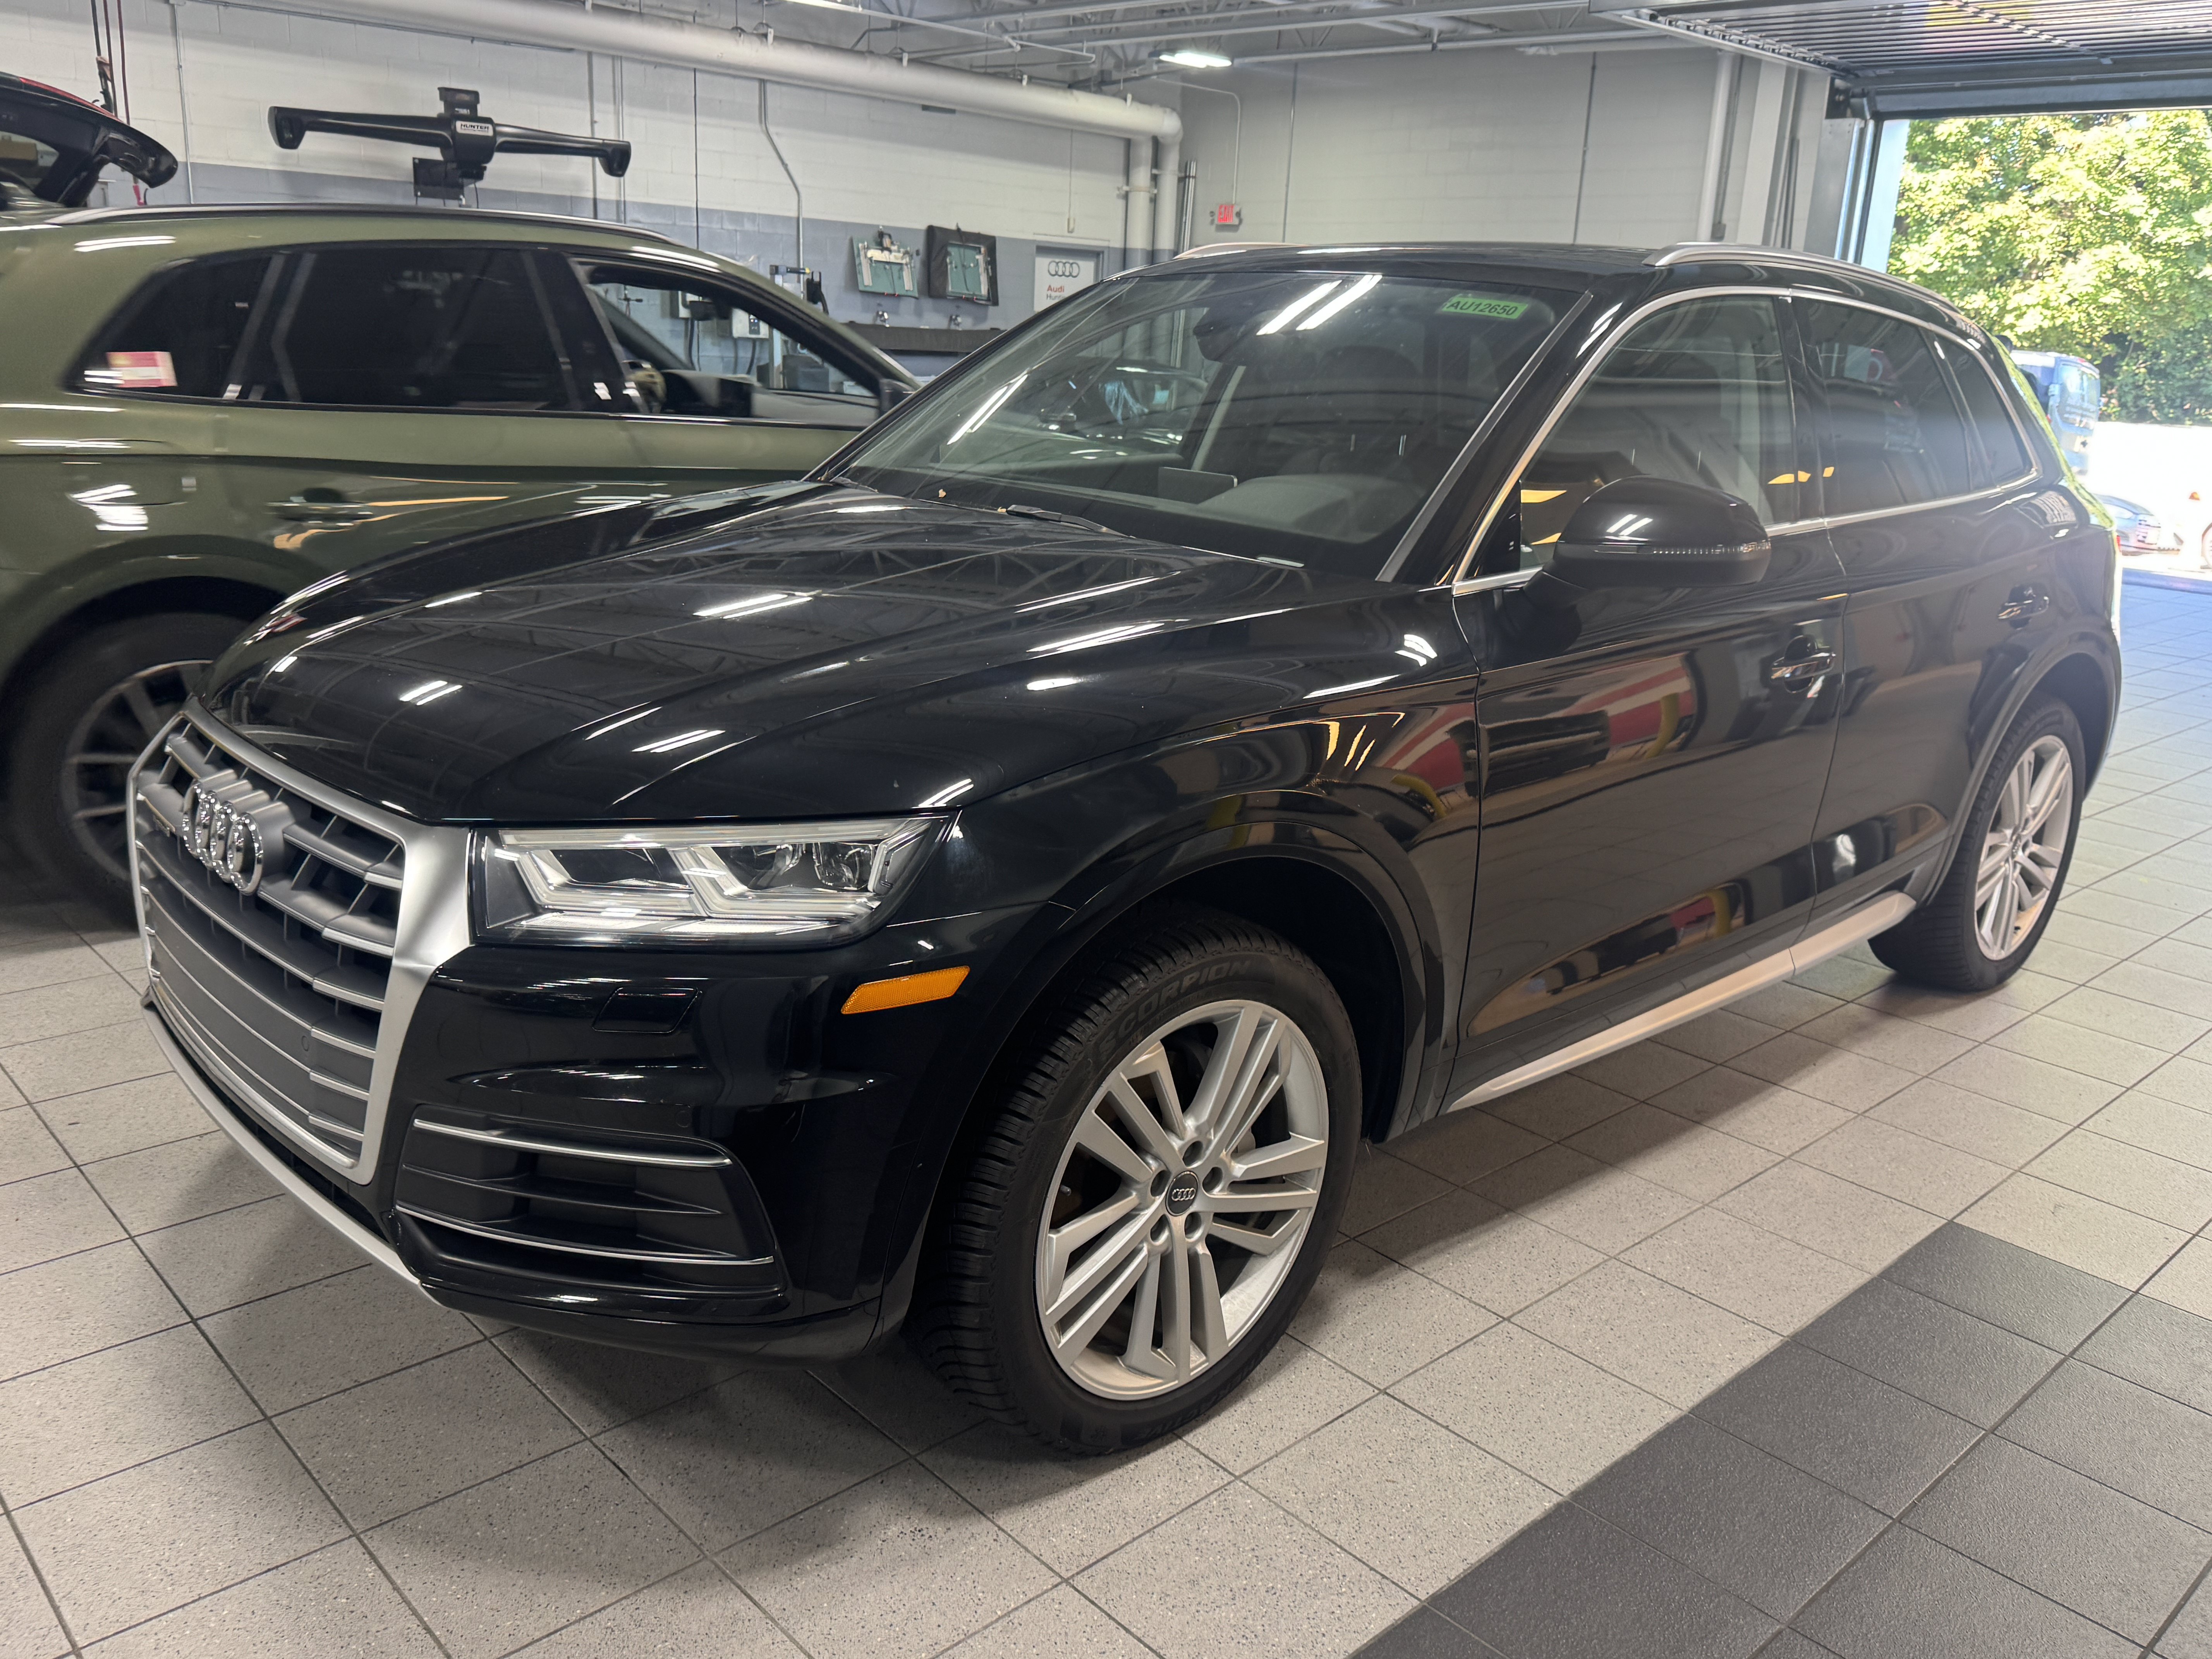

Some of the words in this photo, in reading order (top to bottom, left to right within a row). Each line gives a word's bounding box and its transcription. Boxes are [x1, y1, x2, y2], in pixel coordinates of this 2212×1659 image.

[460, 124, 489, 132] HUNTER
[1447, 301, 1518, 316] AU12650
[1098, 961, 1250, 1058] SCORPION
